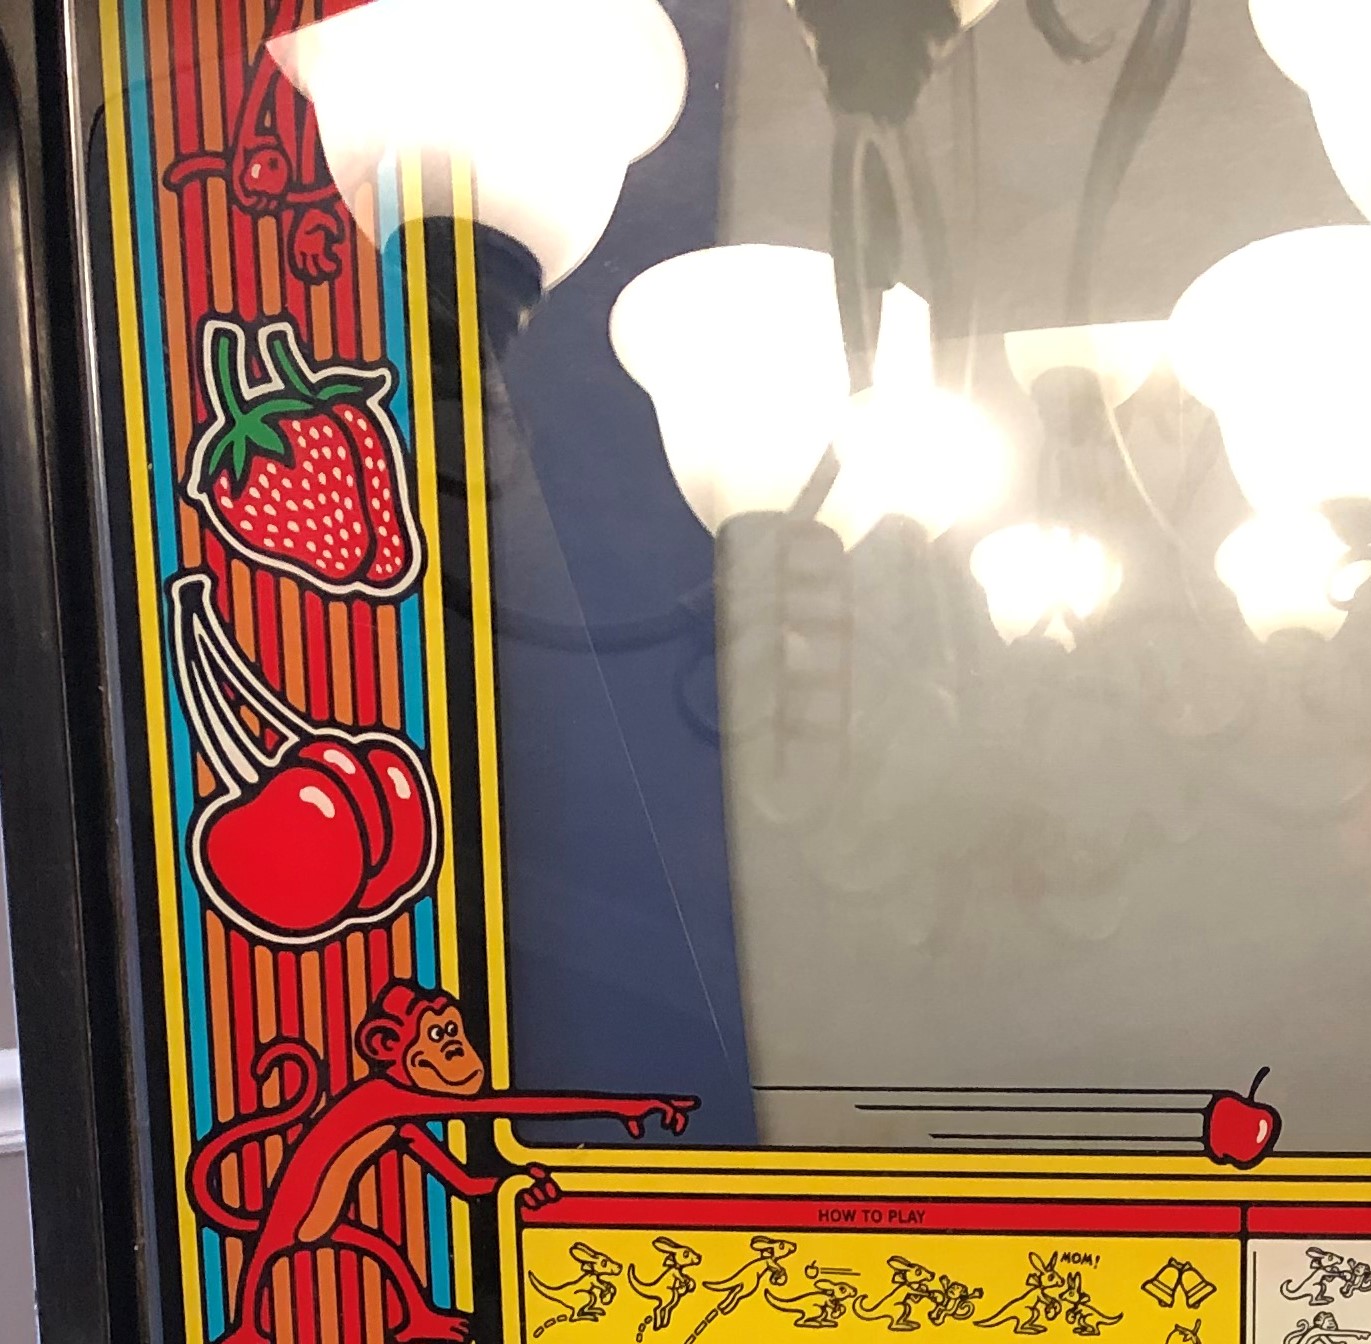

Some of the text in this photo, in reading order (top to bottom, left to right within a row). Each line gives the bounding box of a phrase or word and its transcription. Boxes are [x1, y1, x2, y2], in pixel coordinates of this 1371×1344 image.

[818, 1209, 926, 1224] HOW TO PLAY
[1060, 1251, 1101, 1270] MOM!
